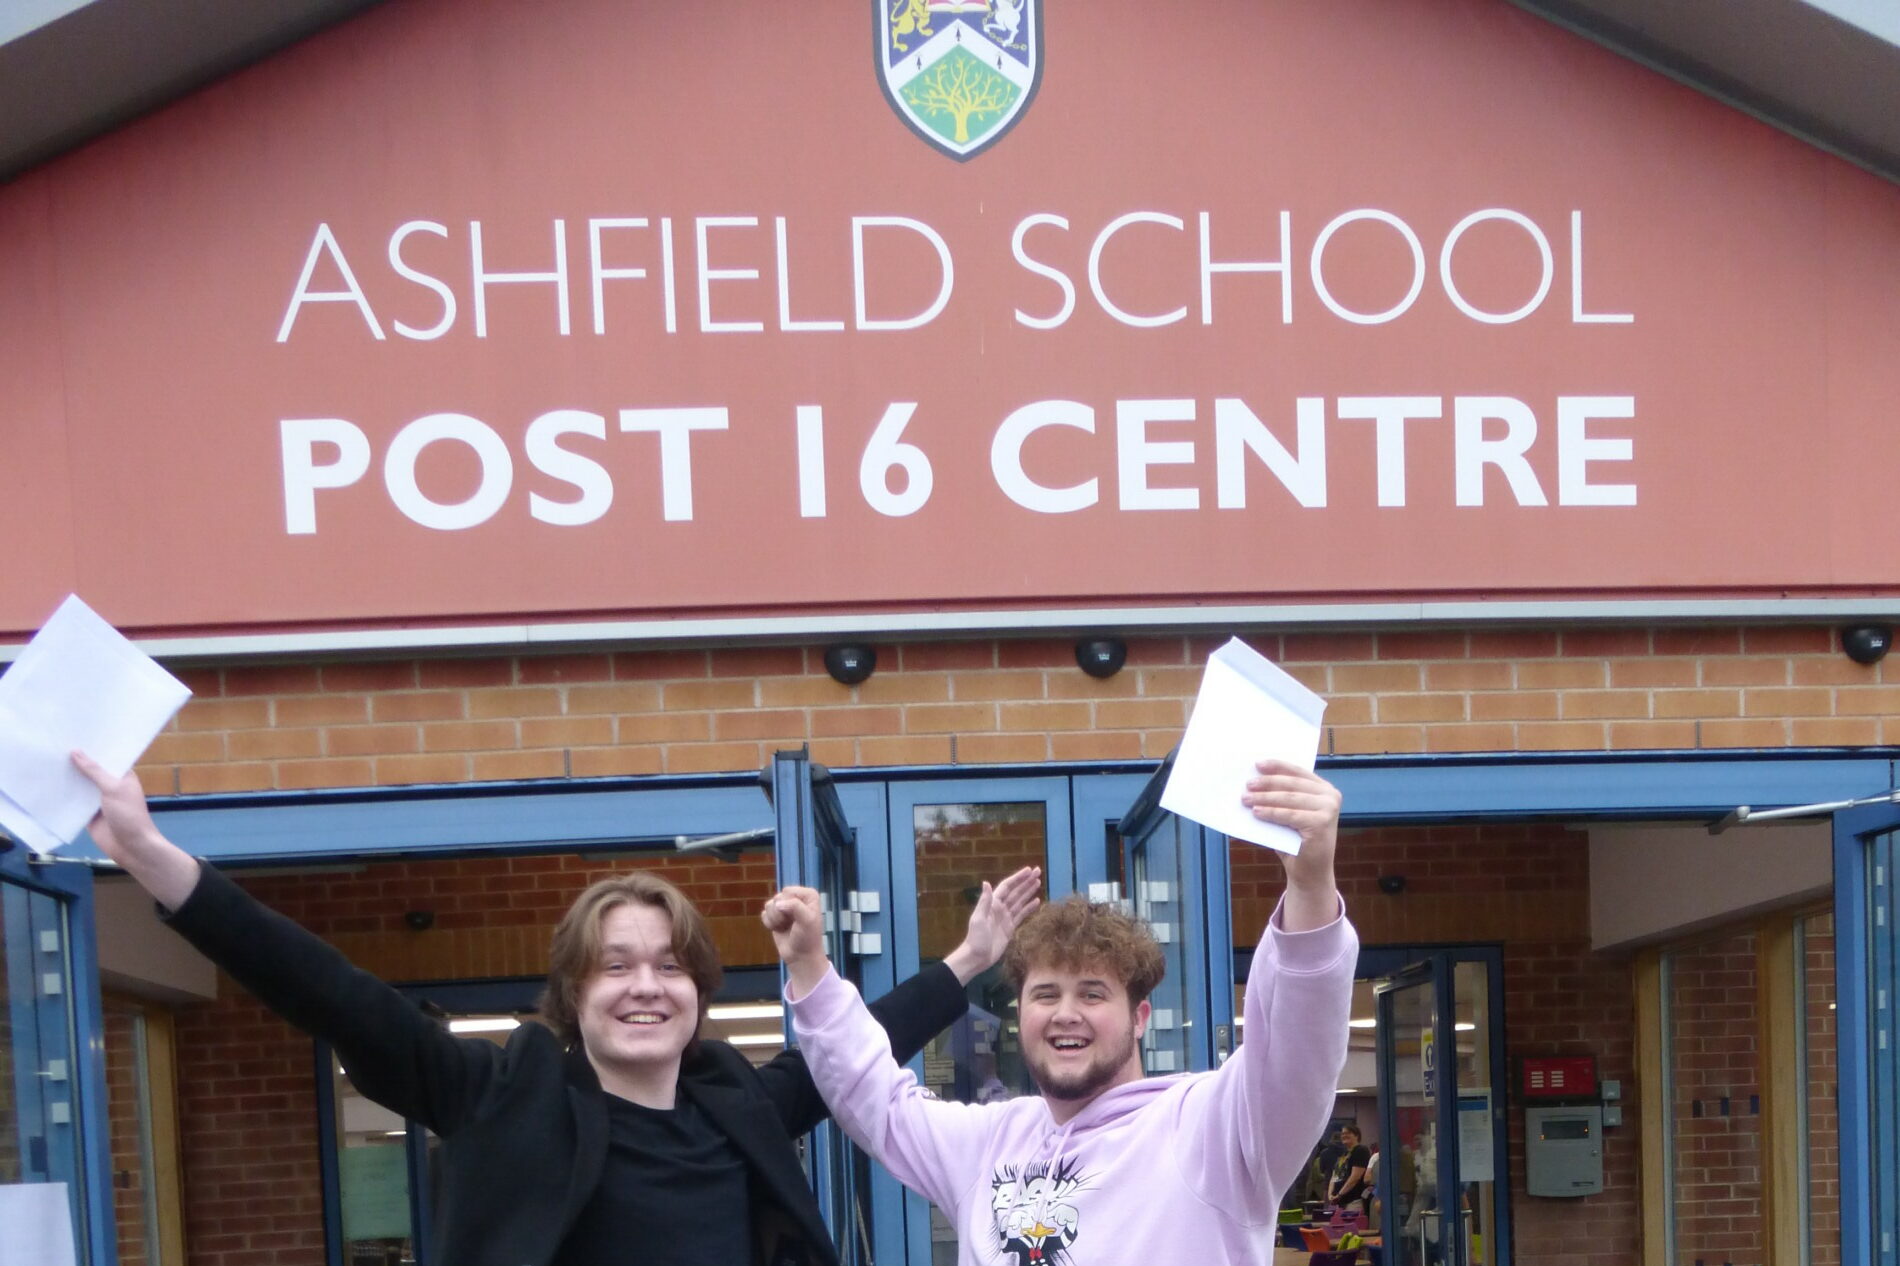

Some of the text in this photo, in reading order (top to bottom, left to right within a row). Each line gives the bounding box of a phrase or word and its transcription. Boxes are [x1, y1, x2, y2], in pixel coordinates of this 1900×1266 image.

[276, 208, 1636, 343] ASHFIELD SCHOOL
[279, 395, 1639, 536] POST 16 CENTRE
